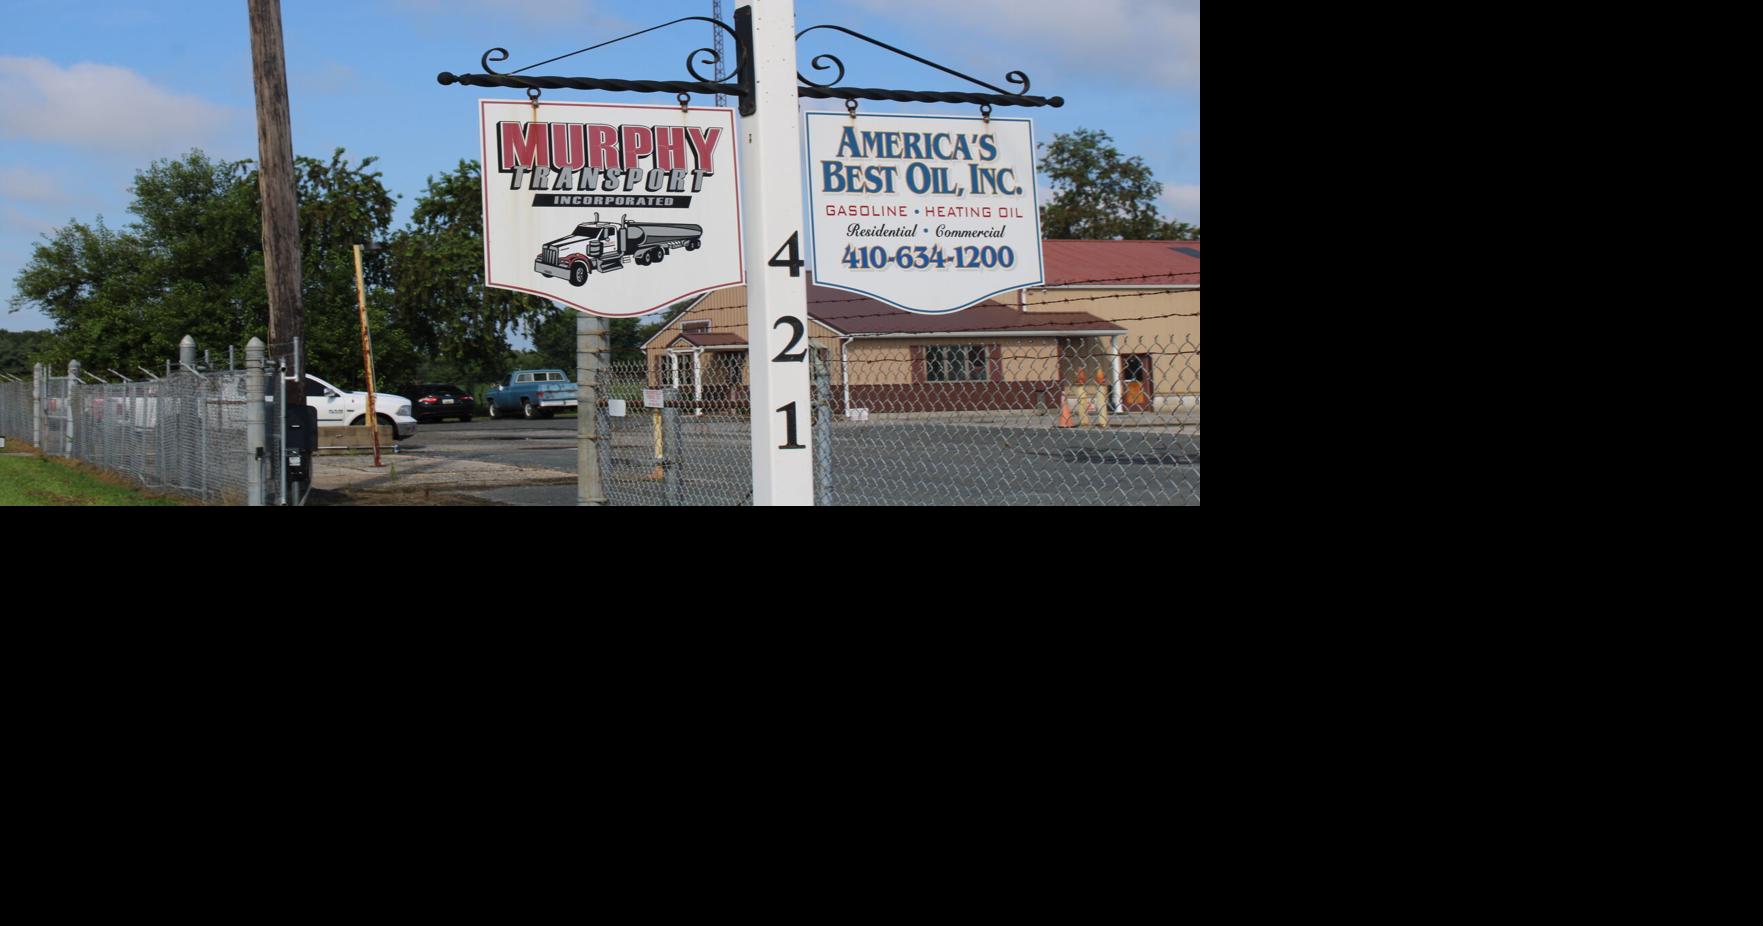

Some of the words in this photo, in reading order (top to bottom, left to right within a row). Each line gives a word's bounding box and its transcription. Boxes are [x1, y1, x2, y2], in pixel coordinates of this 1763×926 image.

[496, 121, 723, 177] MURPHY
[836, 126, 998, 161] AMERICA'S
[510, 165, 711, 192] TRANSPORT
[821, 160, 898, 194] BEST
[906, 162, 965, 197] OIL,
[969, 163, 1023, 195] INC.
[553, 195, 674, 206] INCORPORATED
[826, 205, 908, 217] GASOLINE
[925, 206, 991, 218] HEATING
[999, 207, 1024, 218] OIL
[846, 223, 918, 237] Residential
[935, 224, 1006, 238] Commercial
[842, 244, 1015, 269] 410-634-1200
